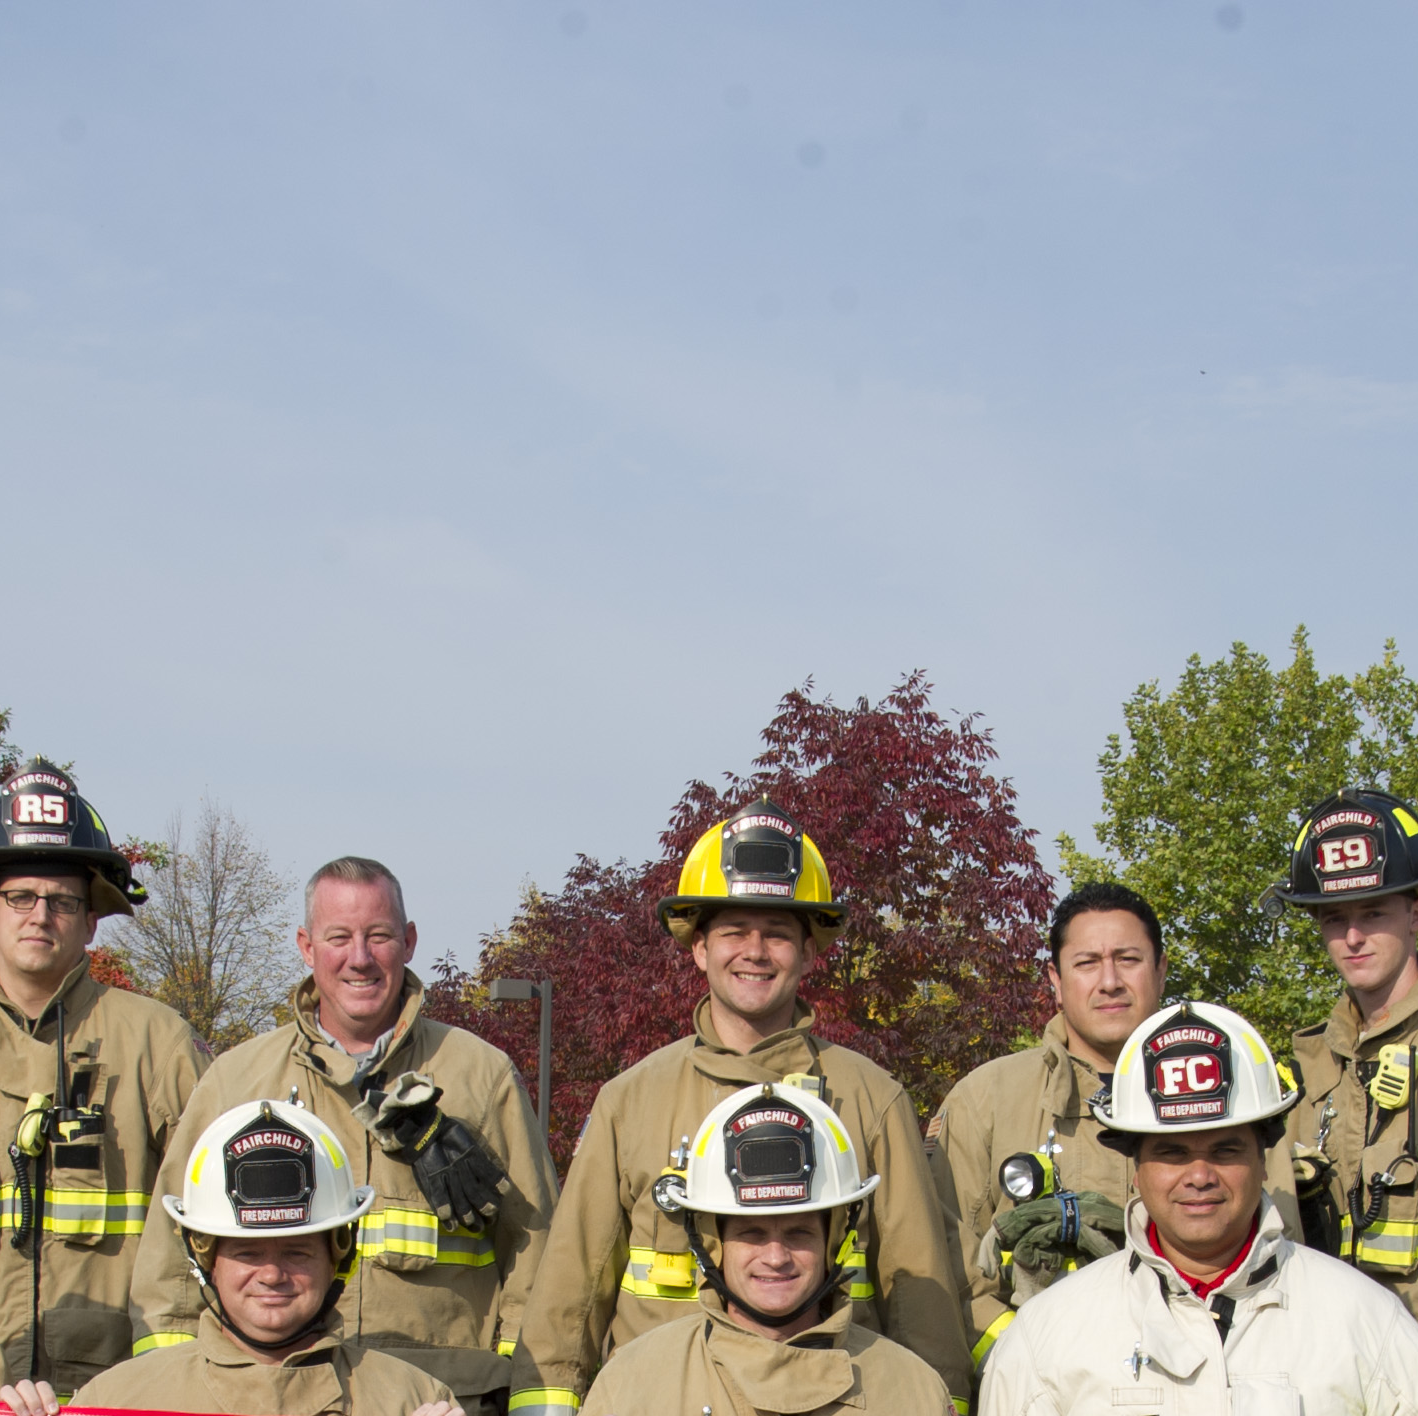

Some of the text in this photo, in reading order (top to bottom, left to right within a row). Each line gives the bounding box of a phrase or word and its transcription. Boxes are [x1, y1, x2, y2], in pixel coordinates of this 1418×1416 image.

[11, 774, 67, 791] FAIRCHILD
[19, 794, 64, 824] R5
[1315, 812, 1372, 833] FAIRCHILD
[1321, 838, 1368, 872] E9
[747, 882, 789, 896] DEPARTMENT
[1156, 1029, 1215, 1048] FAIRCHILD
[1161, 1056, 1215, 1095] FC
[1161, 1102, 1221, 1117] FIRE DEPARTMENT
[738, 1111, 798, 1129] FAIRCHILD
[234, 1133, 301, 1153] FAIRCHILD
[741, 1185, 803, 1199] FIRE DEPARTMENT
[241, 1208, 303, 1221] FIRE DEPARTMENT
